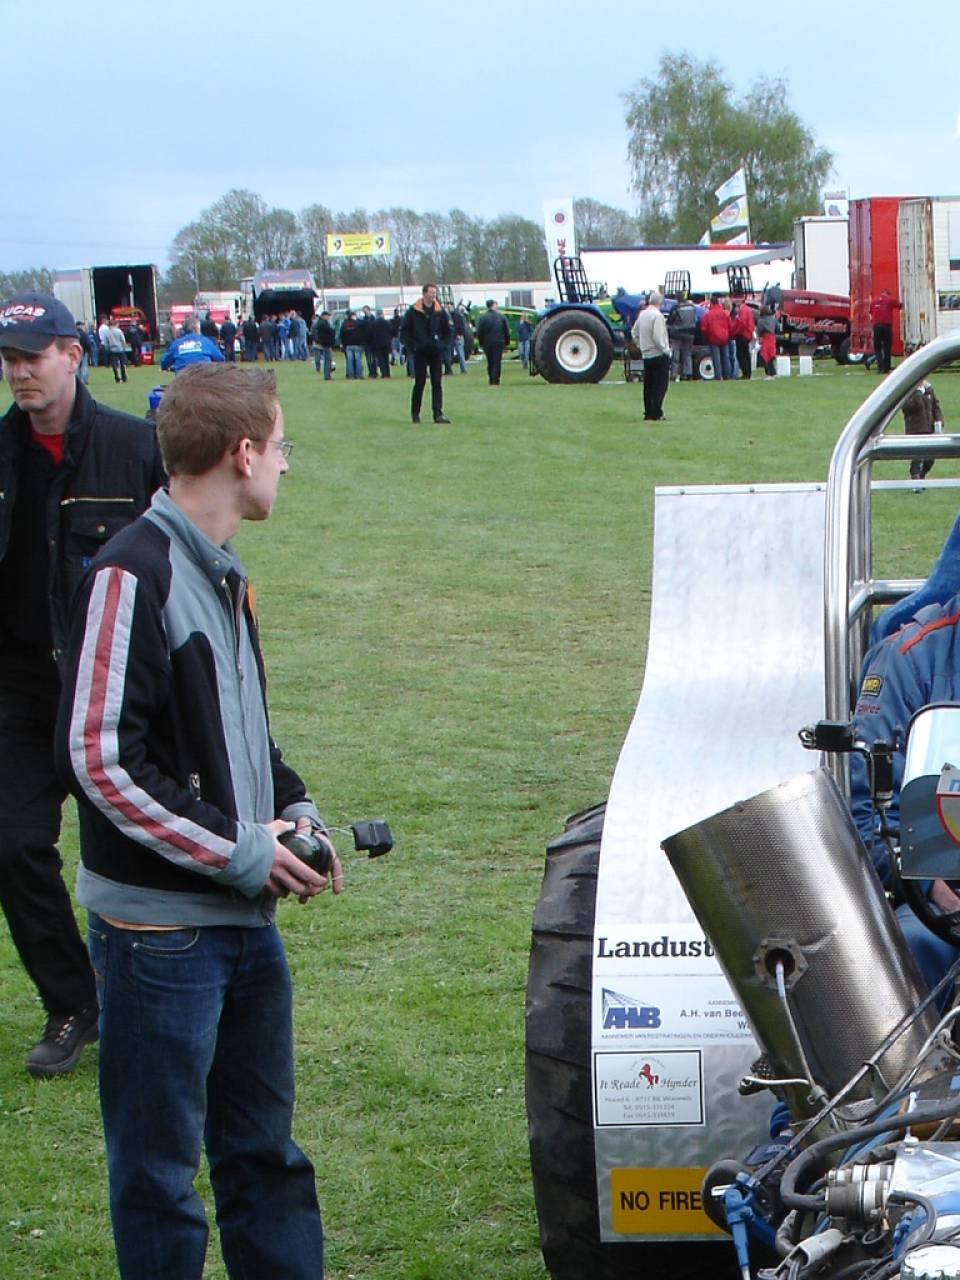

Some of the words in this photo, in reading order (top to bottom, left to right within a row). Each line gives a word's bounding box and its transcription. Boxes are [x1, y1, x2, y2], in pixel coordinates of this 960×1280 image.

[703, 1010, 722, 1018] van
[620, 1191, 650, 1210] NO
[659, 1191, 704, 1210] FIRE
